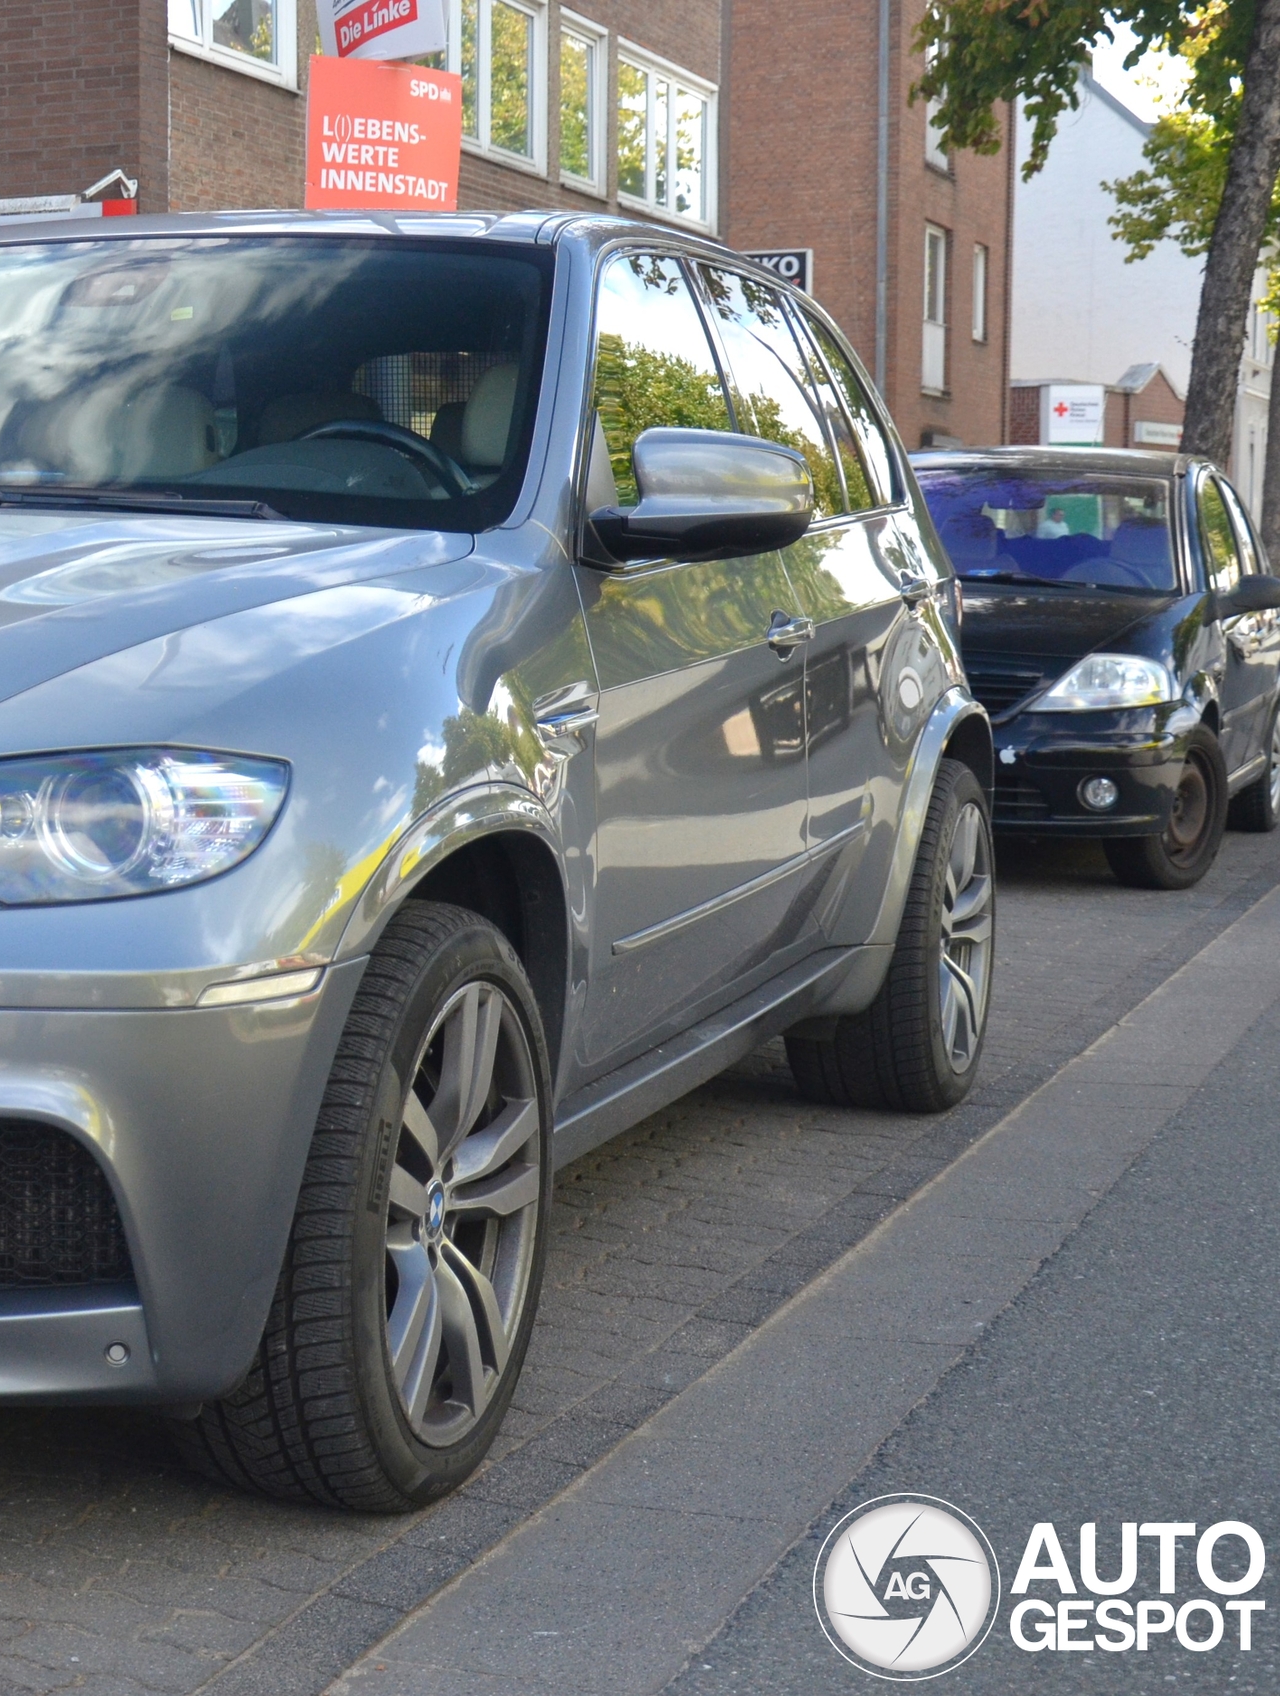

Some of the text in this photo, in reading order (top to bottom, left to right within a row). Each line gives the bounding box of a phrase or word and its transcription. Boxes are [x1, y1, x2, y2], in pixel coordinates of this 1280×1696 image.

[340, 0, 411, 49] Die Linke
[410, 79, 439, 100] SPD
[322, 114, 427, 145] L(I)EBENS-
[322, 142, 400, 168] WERTE
[320, 168, 449, 202] INNENSTADT
